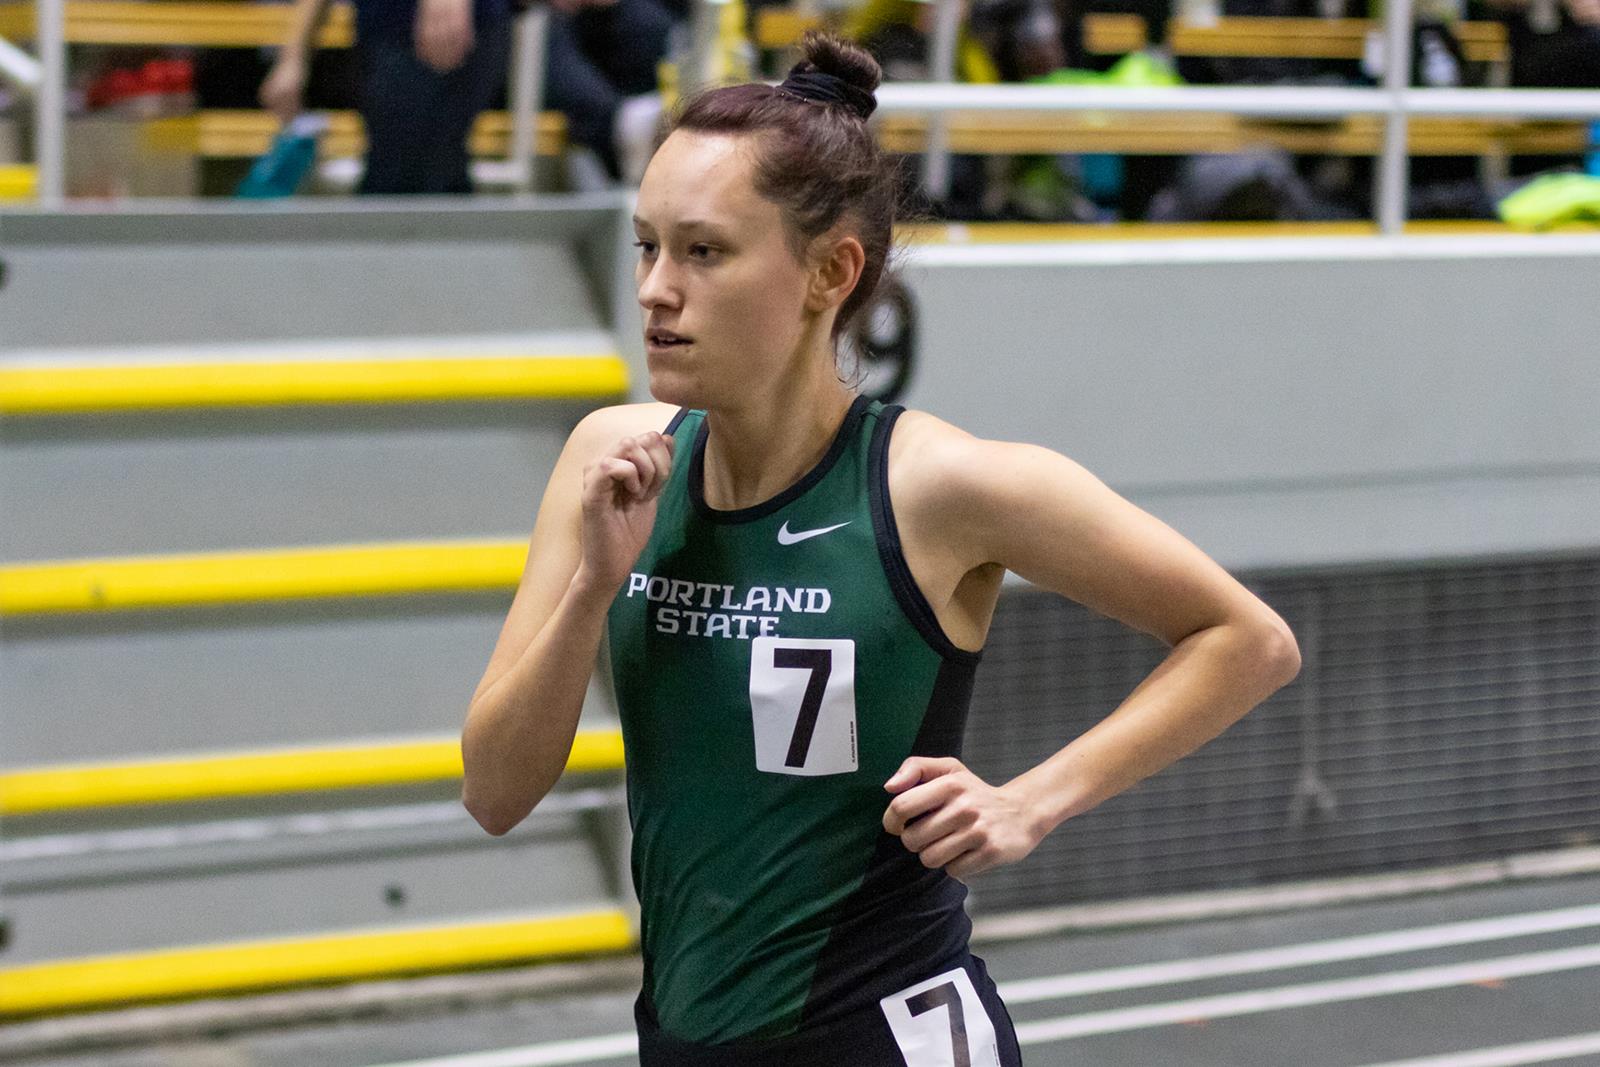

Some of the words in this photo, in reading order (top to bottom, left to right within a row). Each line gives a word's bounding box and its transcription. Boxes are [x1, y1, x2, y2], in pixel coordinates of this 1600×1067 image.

[858, 279, 918, 404] 9
[627, 572, 832, 613] PORTLAND
[656, 608, 780, 639] STATE
[773, 647, 832, 768] 7
[904, 981, 971, 1067] 7
